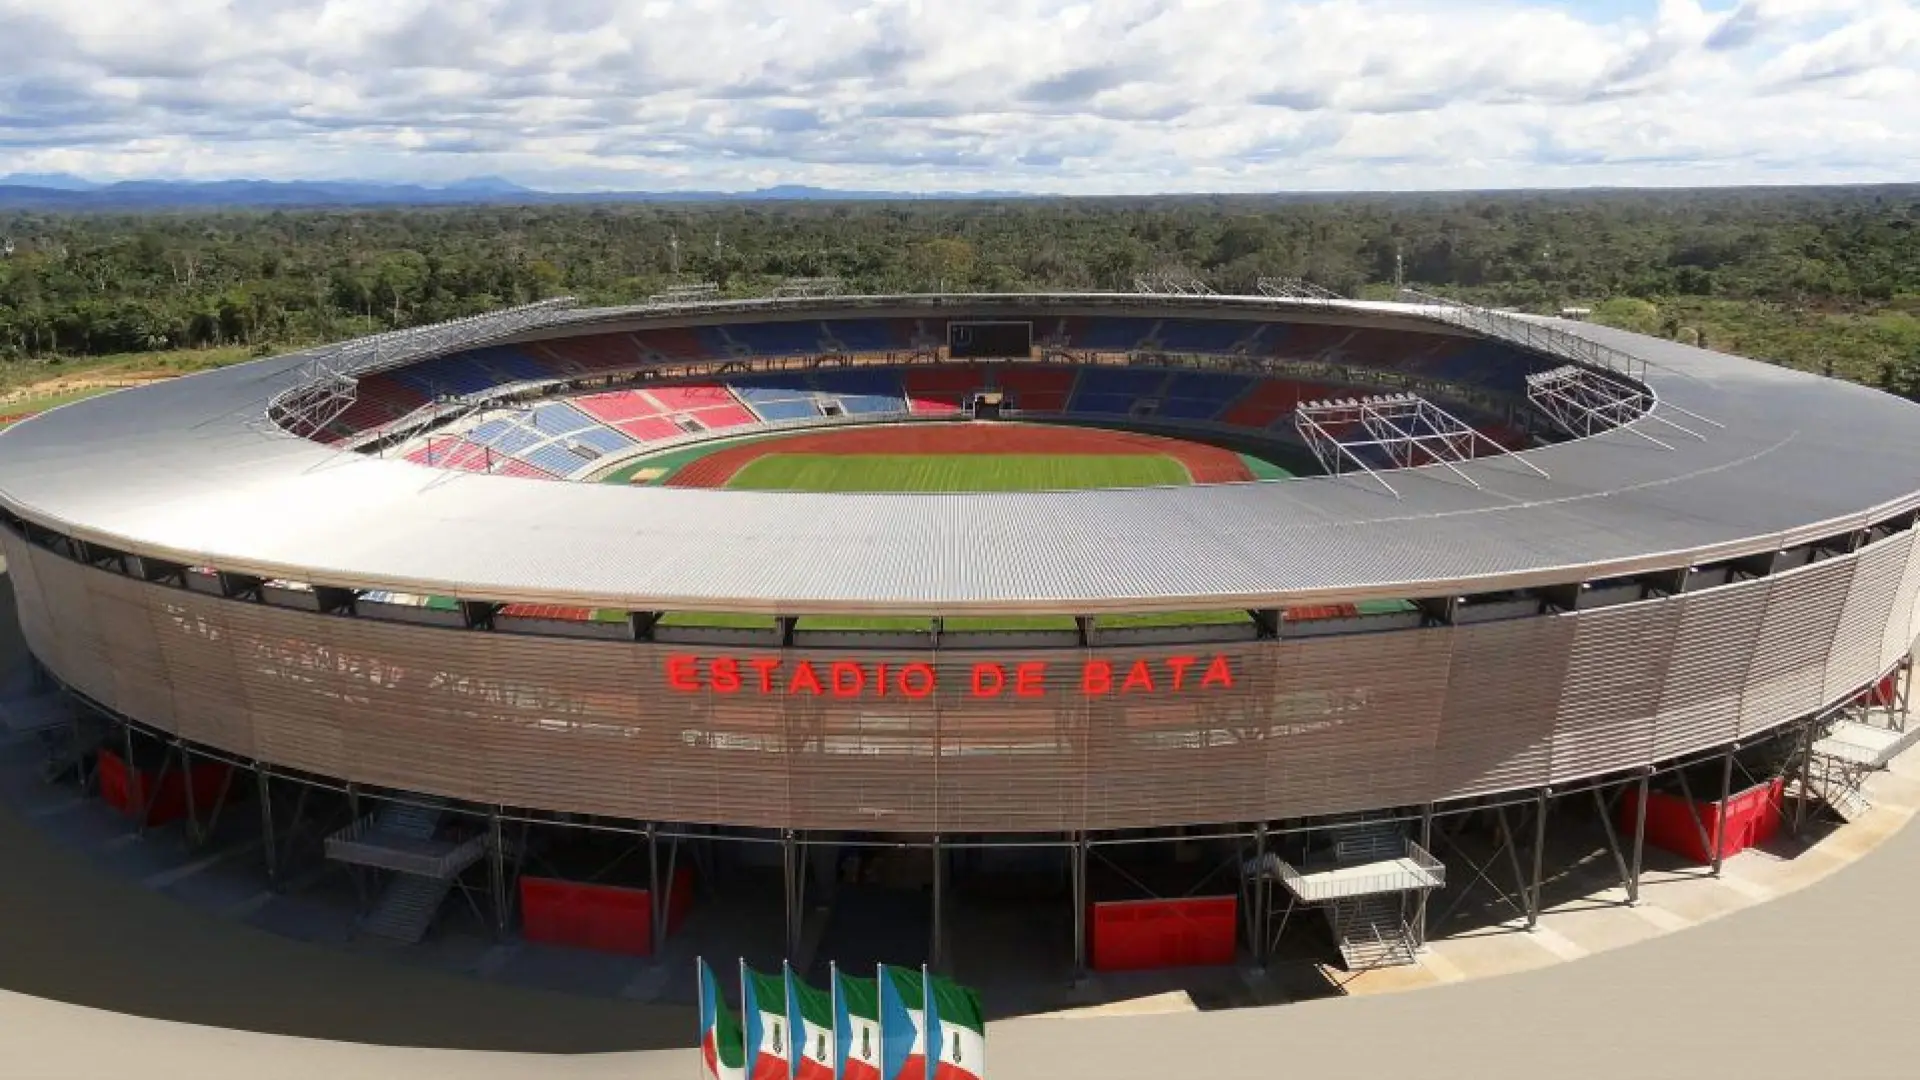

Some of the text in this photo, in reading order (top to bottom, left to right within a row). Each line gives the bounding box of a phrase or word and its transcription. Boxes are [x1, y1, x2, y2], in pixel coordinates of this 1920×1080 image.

[664, 651, 1233, 700] ESTADIO DE BATA
